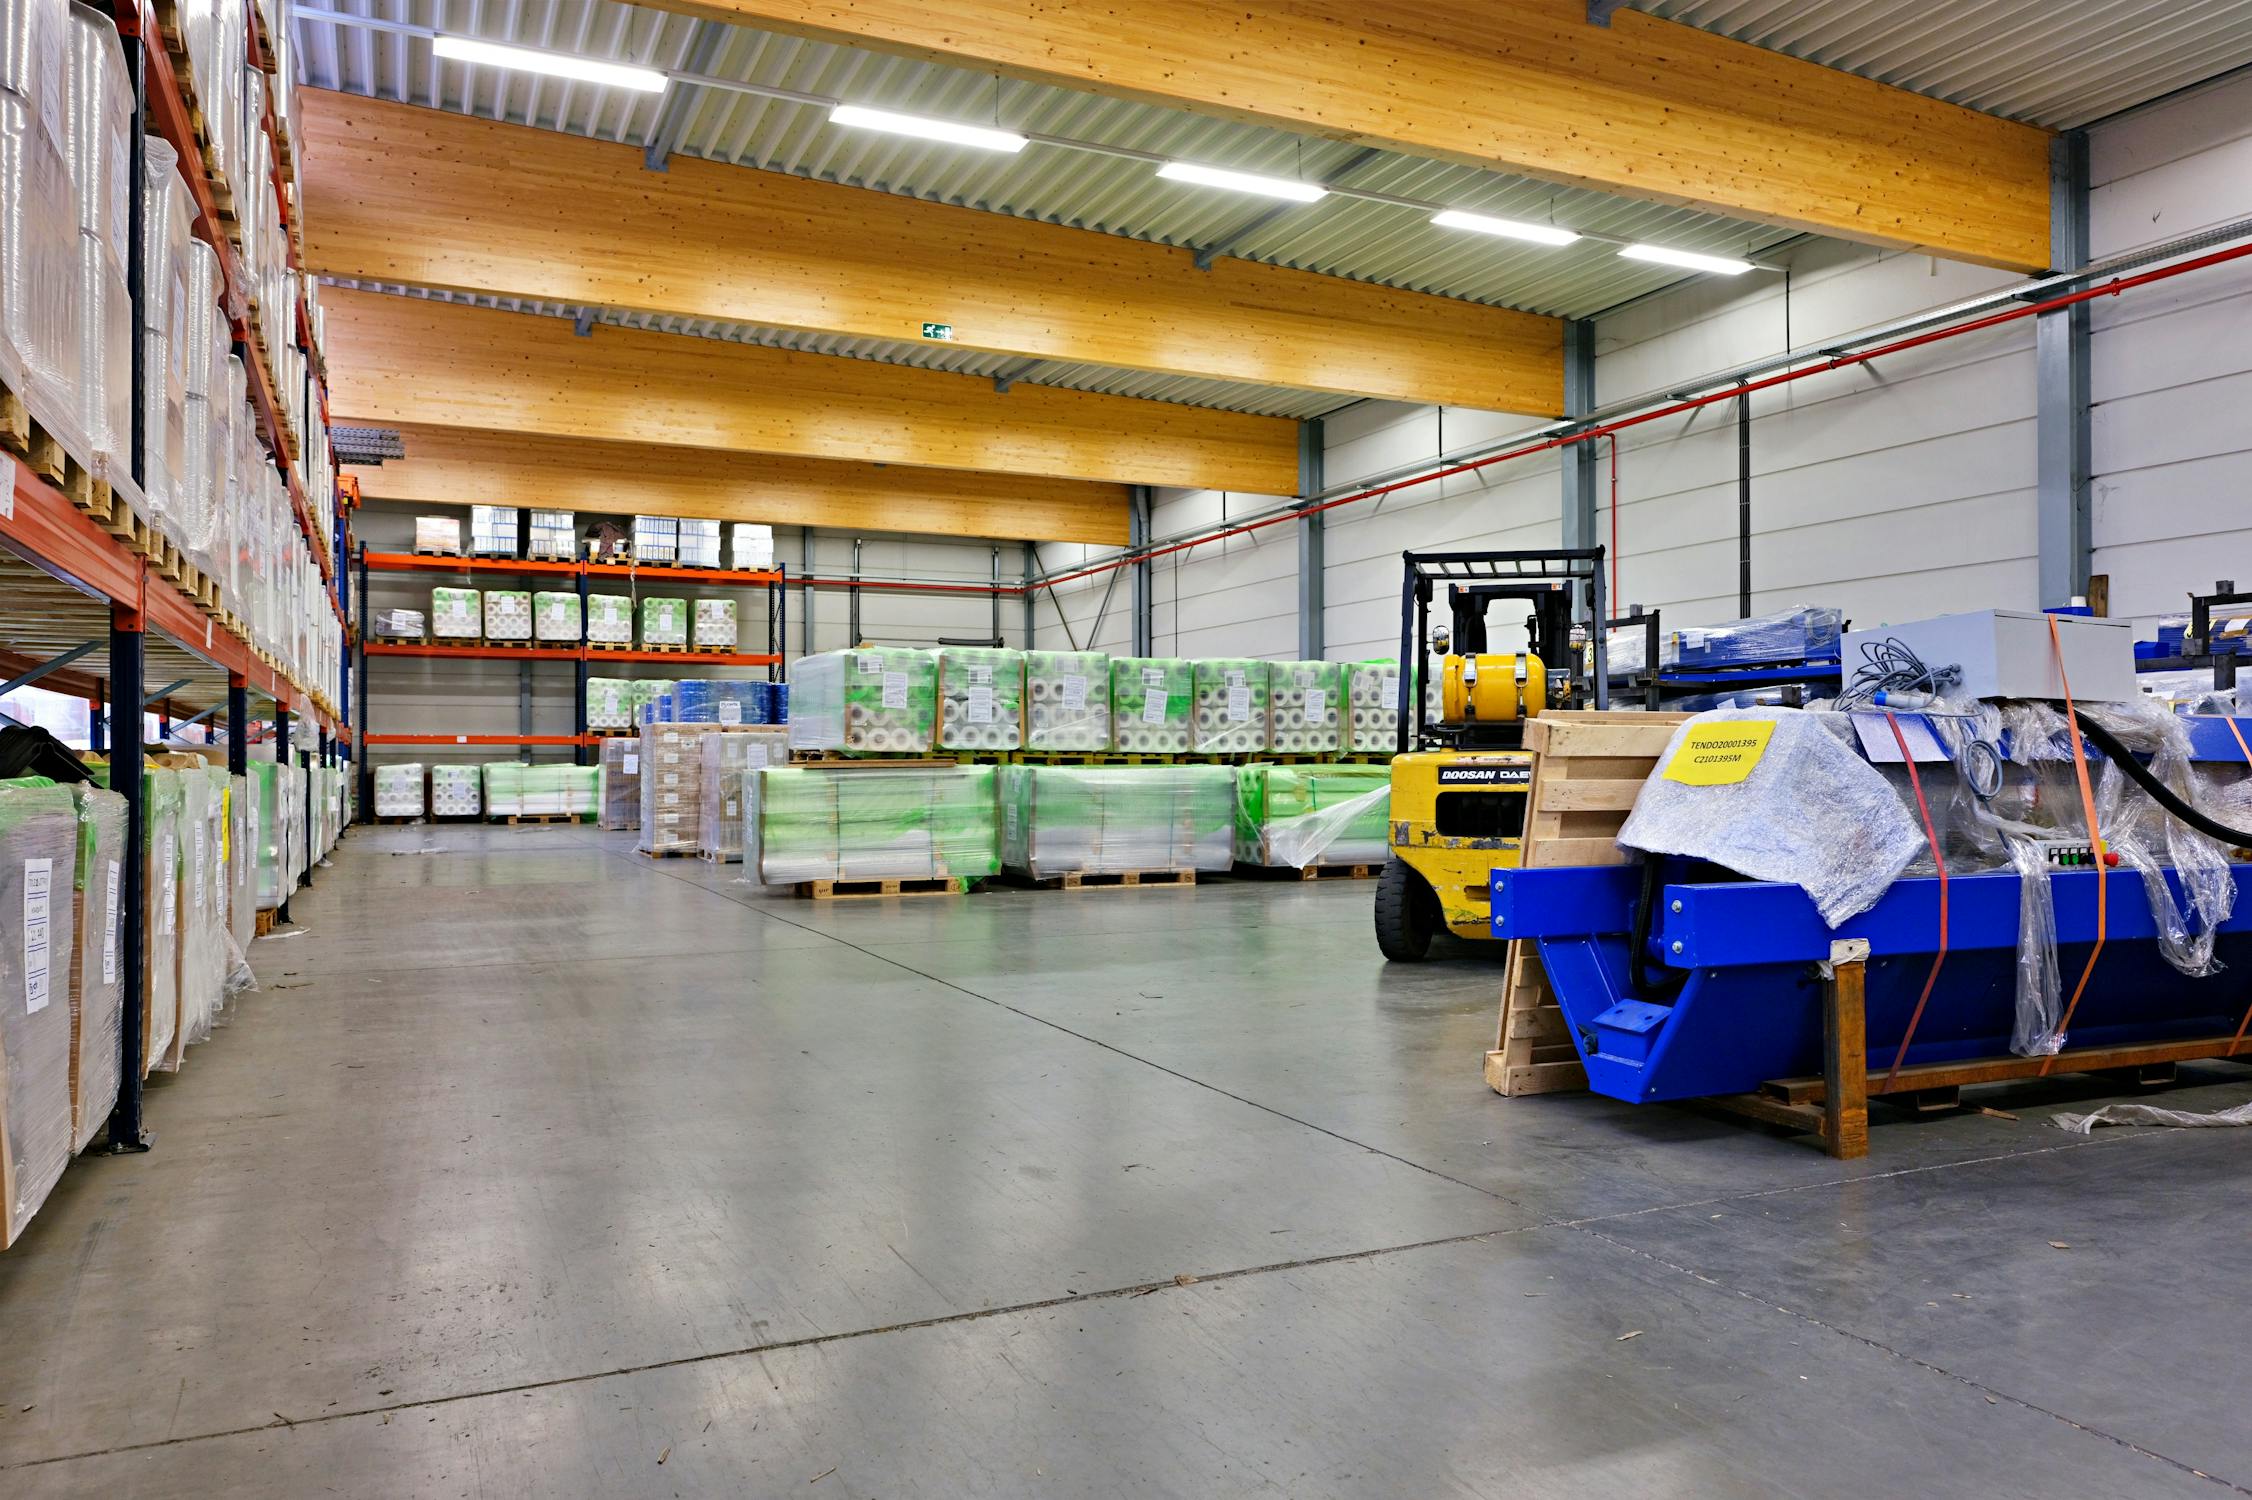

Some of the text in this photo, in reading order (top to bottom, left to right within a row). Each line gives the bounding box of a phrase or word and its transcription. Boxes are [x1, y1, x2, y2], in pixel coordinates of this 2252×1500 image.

[1693, 754, 1742, 764] C2101395M
[1441, 770, 1531, 780] DOOSAN DAE
